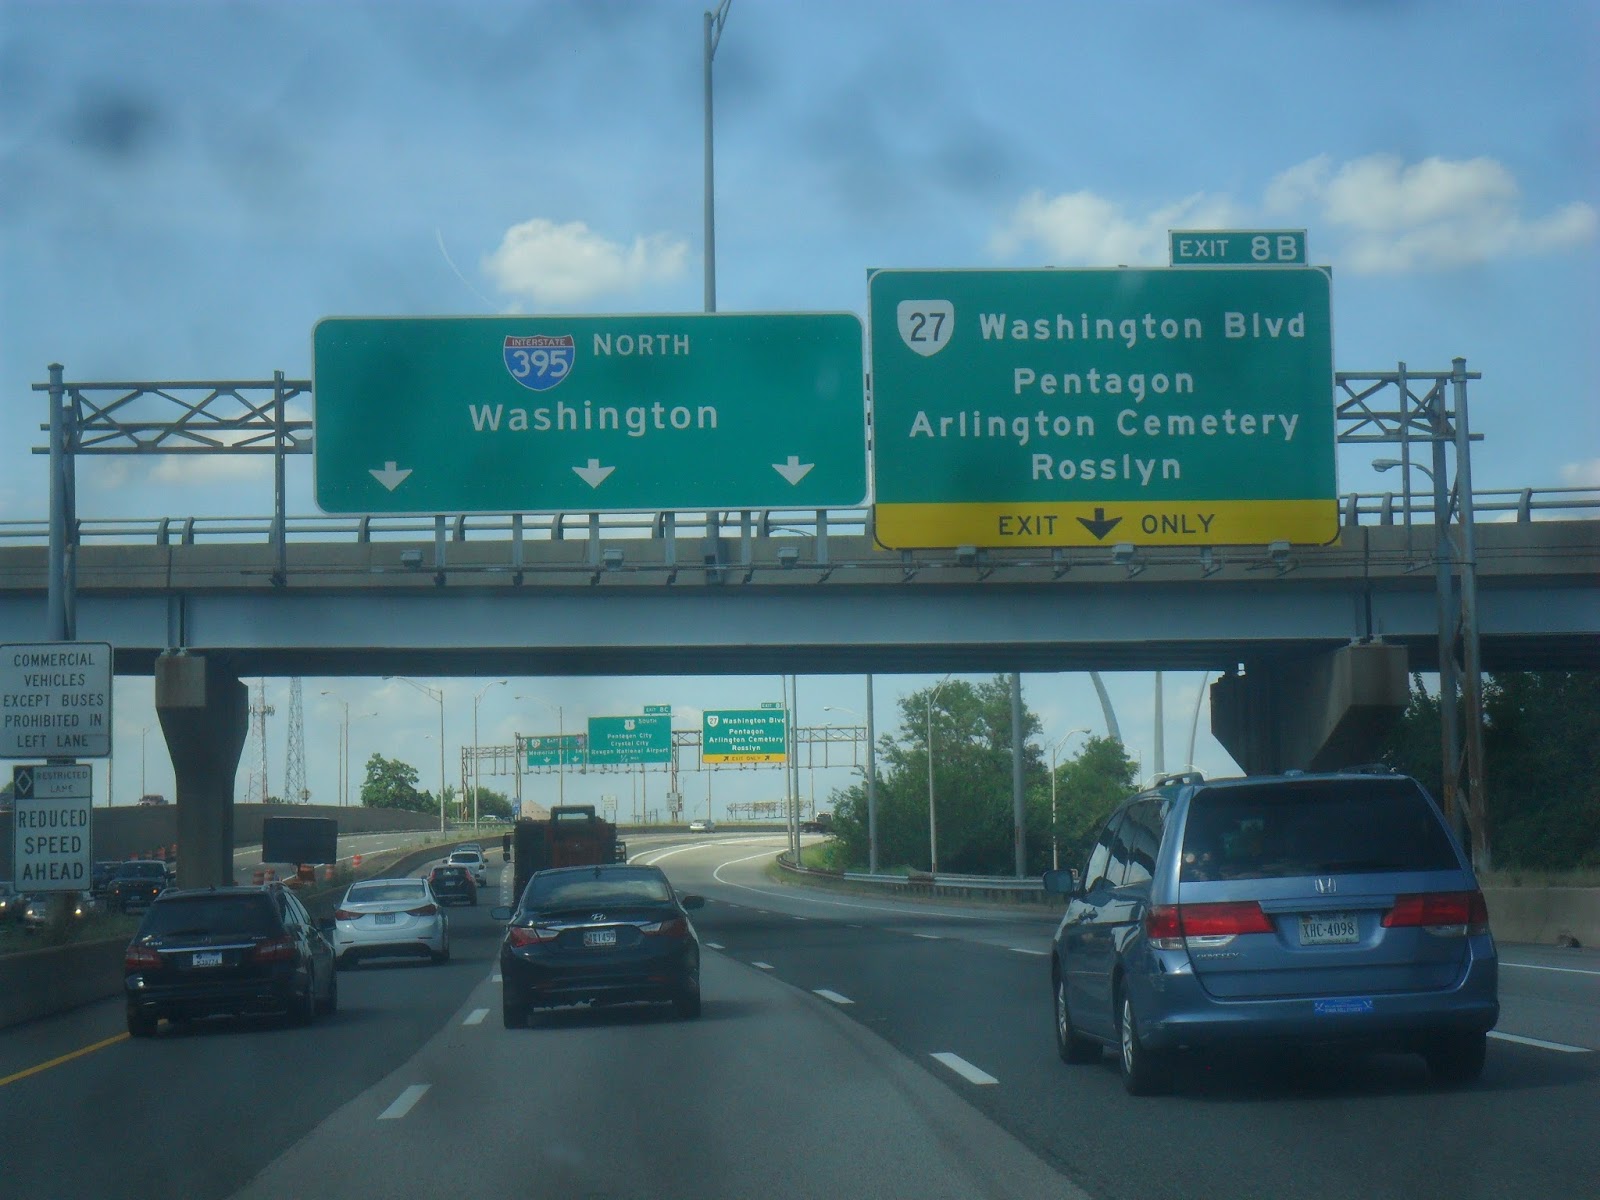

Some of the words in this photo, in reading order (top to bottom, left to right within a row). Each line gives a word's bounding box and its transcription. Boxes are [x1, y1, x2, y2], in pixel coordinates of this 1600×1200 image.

[1180, 240, 1228, 257] EXIT
[1251, 236, 1298, 260] 8B
[910, 312, 946, 342] 27
[979, 313, 1201, 348] Washington
[1225, 312, 1305, 338] Blvd
[512, 338, 566, 346] INTERSTATE
[593, 333, 690, 356] NORTH
[512, 350, 568, 377] 395
[1014, 368, 1194, 402] Pentagon
[469, 400, 718, 437] Washington
[909, 411, 1095, 446] Arlington
[1117, 409, 1299, 441] Cemetery
[1033, 454, 1181, 486] Rosslyn
[999, 515, 1058, 536] EXIT
[1142, 513, 1216, 534] ONLY
[14, 653, 96, 667] COMMERCIAL
[24, 673, 86, 687] VEHICLES
[3, 694, 51, 707] EXCEPT
[62, 693, 104, 706] BUSES
[5, 714, 80, 728] PROHIBITED
[89, 713, 102, 726] IN
[709, 717, 717, 725] 27
[722, 717, 766, 725] Washington
[708, 736, 745, 744] Arlington
[728, 728, 764, 736] Pentagon
[17, 735, 47, 748] LEFT
[57, 734, 88, 747] LANE
[731, 744, 761, 752] Rosslyn
[37, 770, 88, 780] RESTRICTED
[50, 784, 73, 793] LANE
[18, 809, 87, 828] REDUCED
[24, 835, 82, 854] SPEED
[23, 862, 84, 880] AHEAD
[1302, 921, 1355, 938] XHC-4098
